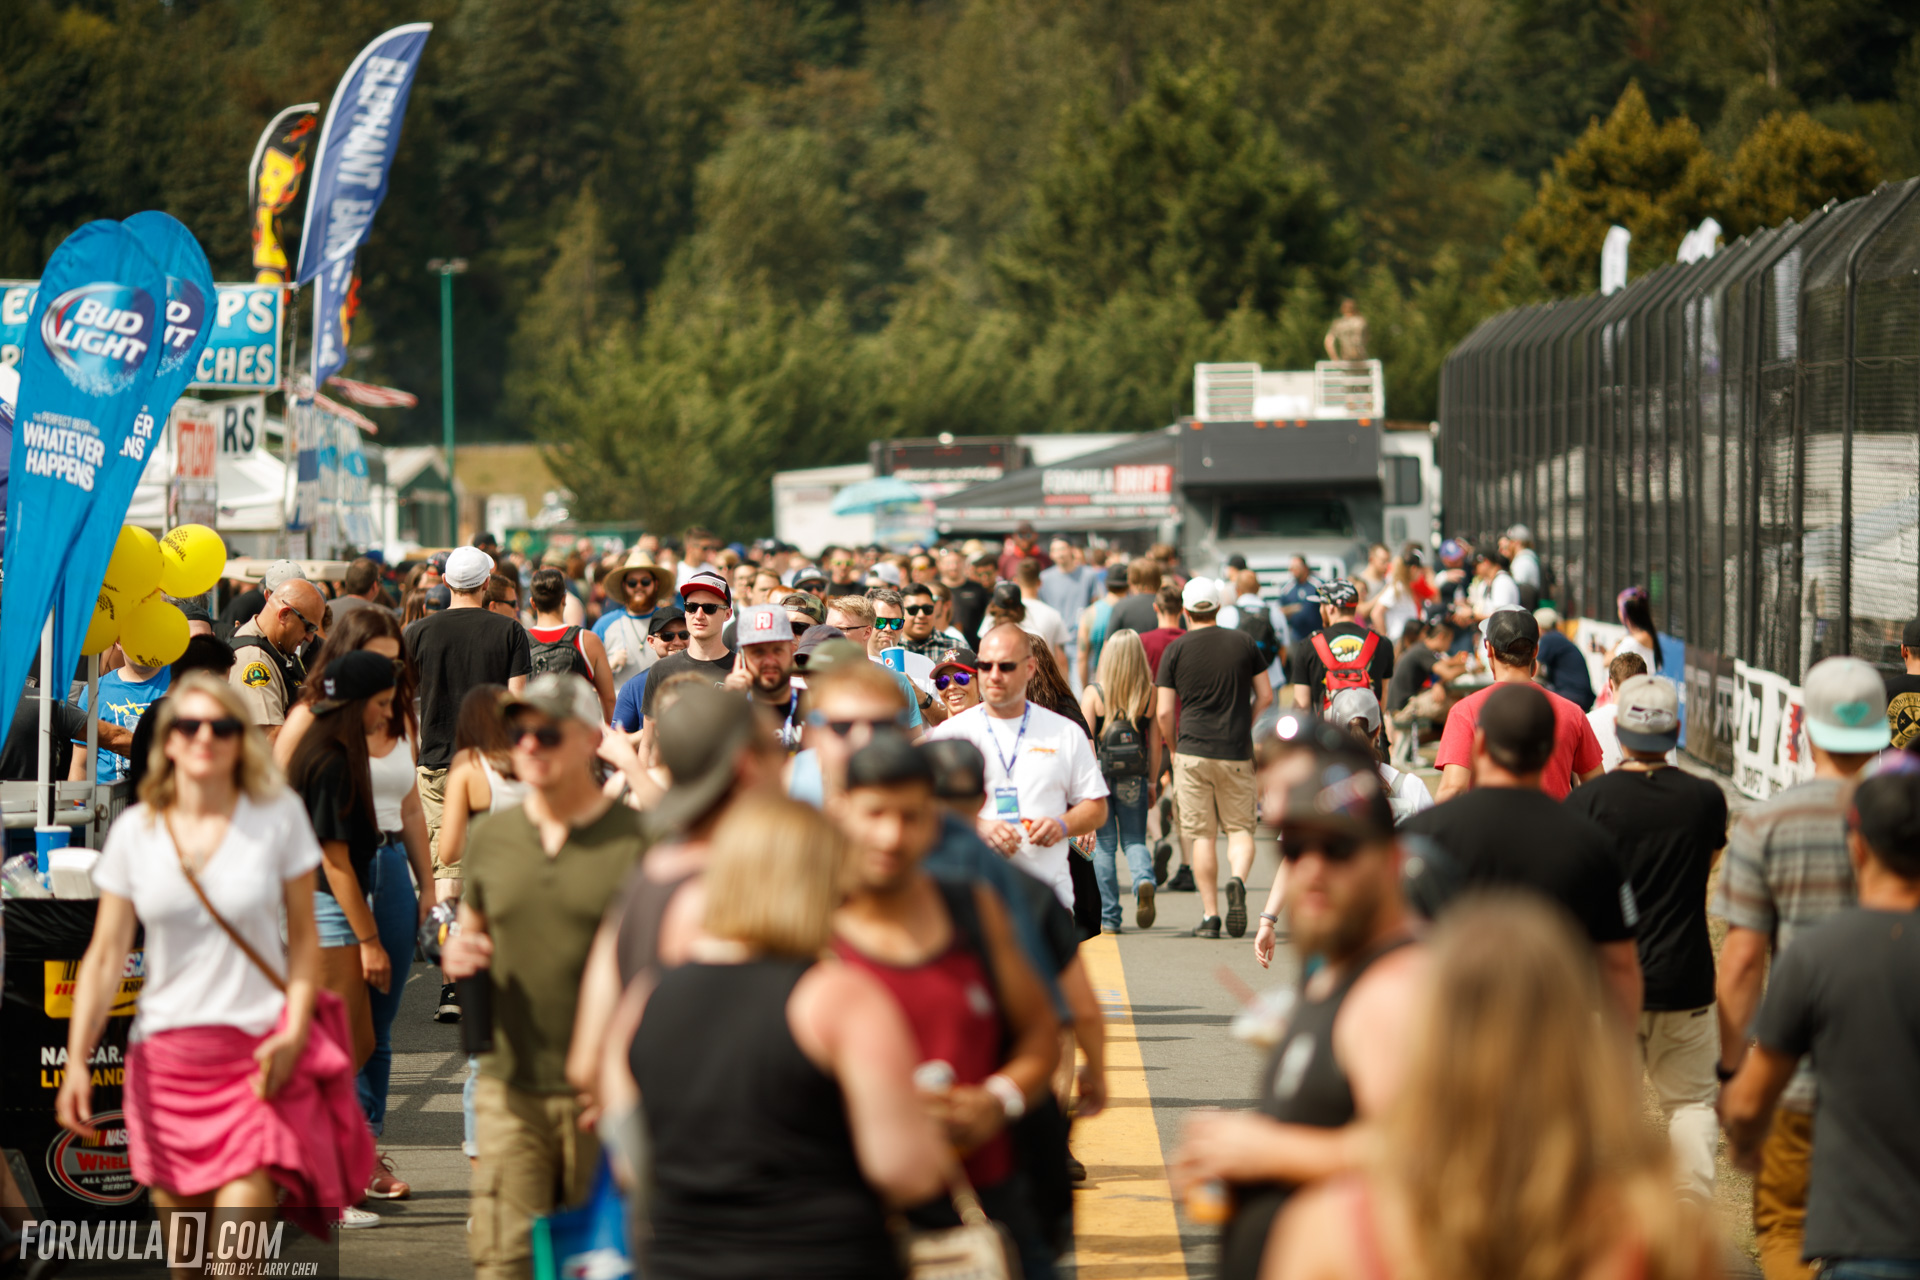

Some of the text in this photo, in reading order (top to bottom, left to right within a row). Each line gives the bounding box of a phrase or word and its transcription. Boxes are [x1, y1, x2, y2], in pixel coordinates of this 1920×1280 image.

[337, 55, 408, 191] ELEPHANT
[74, 298, 143, 336] BUD
[55, 319, 147, 362] LIGHT
[42, 411, 72, 428] PERFECT
[23, 420, 105, 468] WHATEVER
[25, 448, 95, 492] HAPPENS
